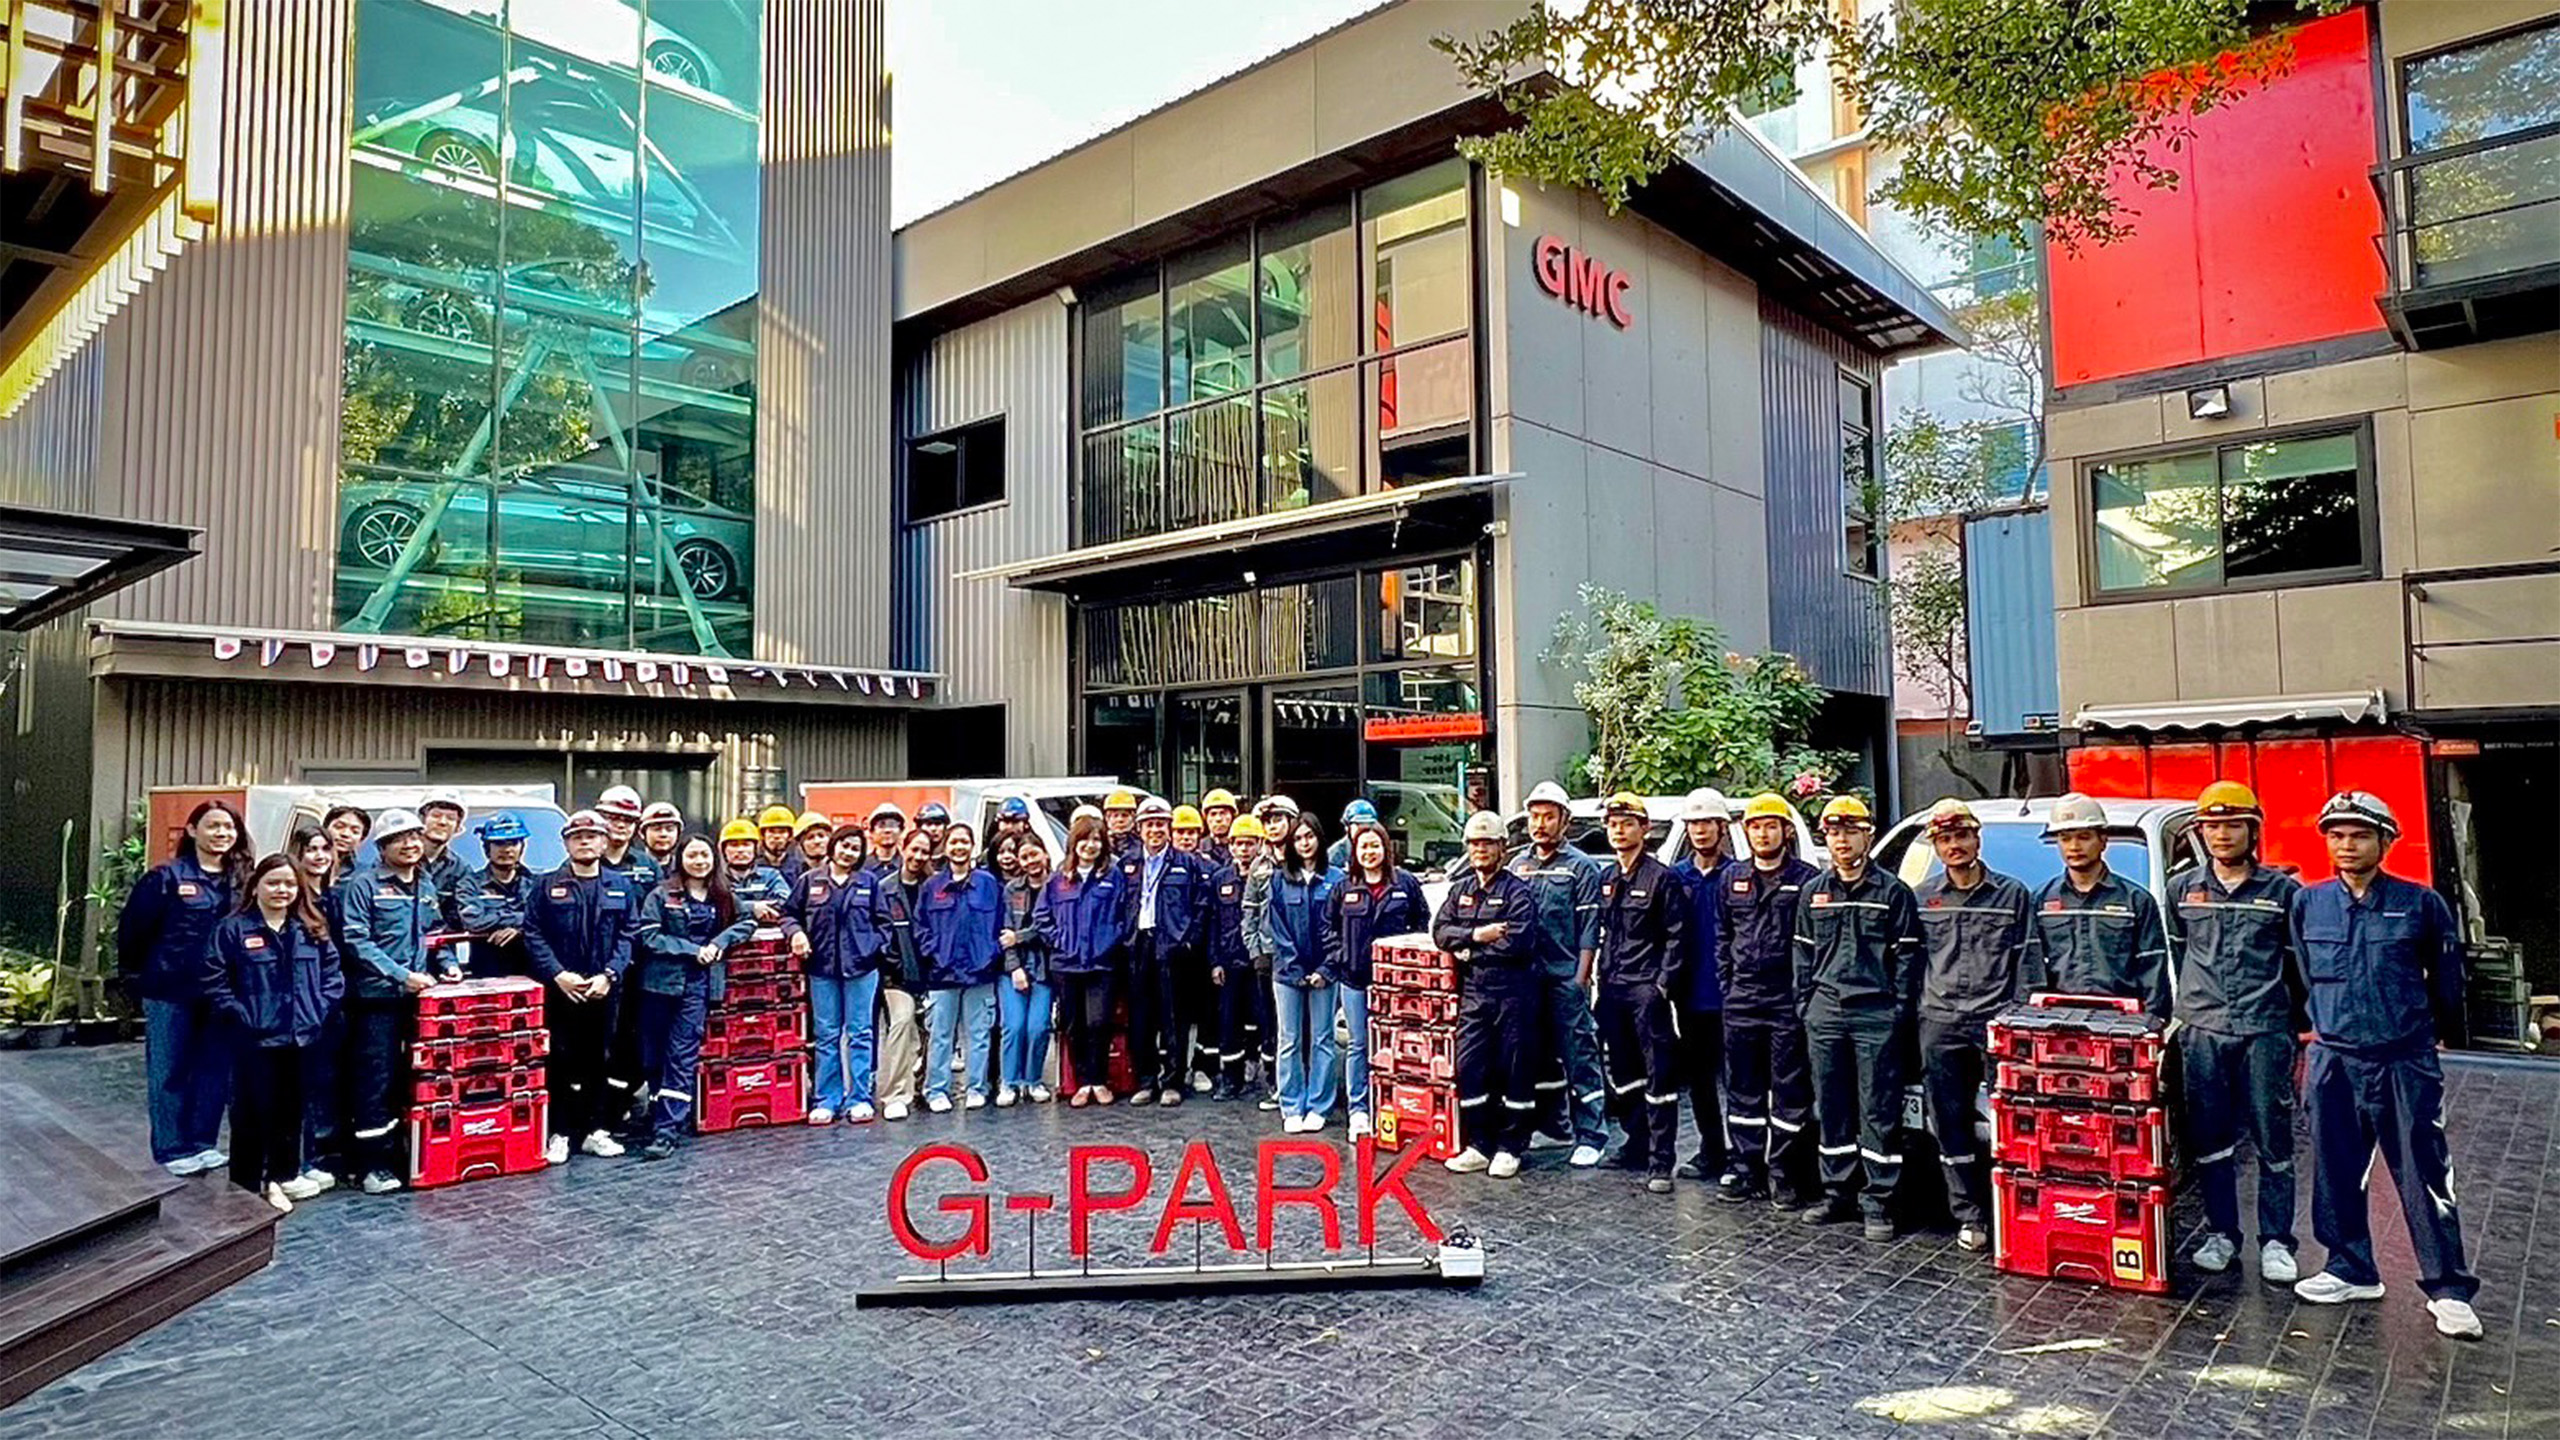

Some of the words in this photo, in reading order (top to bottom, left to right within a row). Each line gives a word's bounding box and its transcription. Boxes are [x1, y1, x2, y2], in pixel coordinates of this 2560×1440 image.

[1531, 235, 1632, 330] GMC
[887, 1133, 1444, 1260] G-PARK
[2116, 1250, 2140, 1269] B
